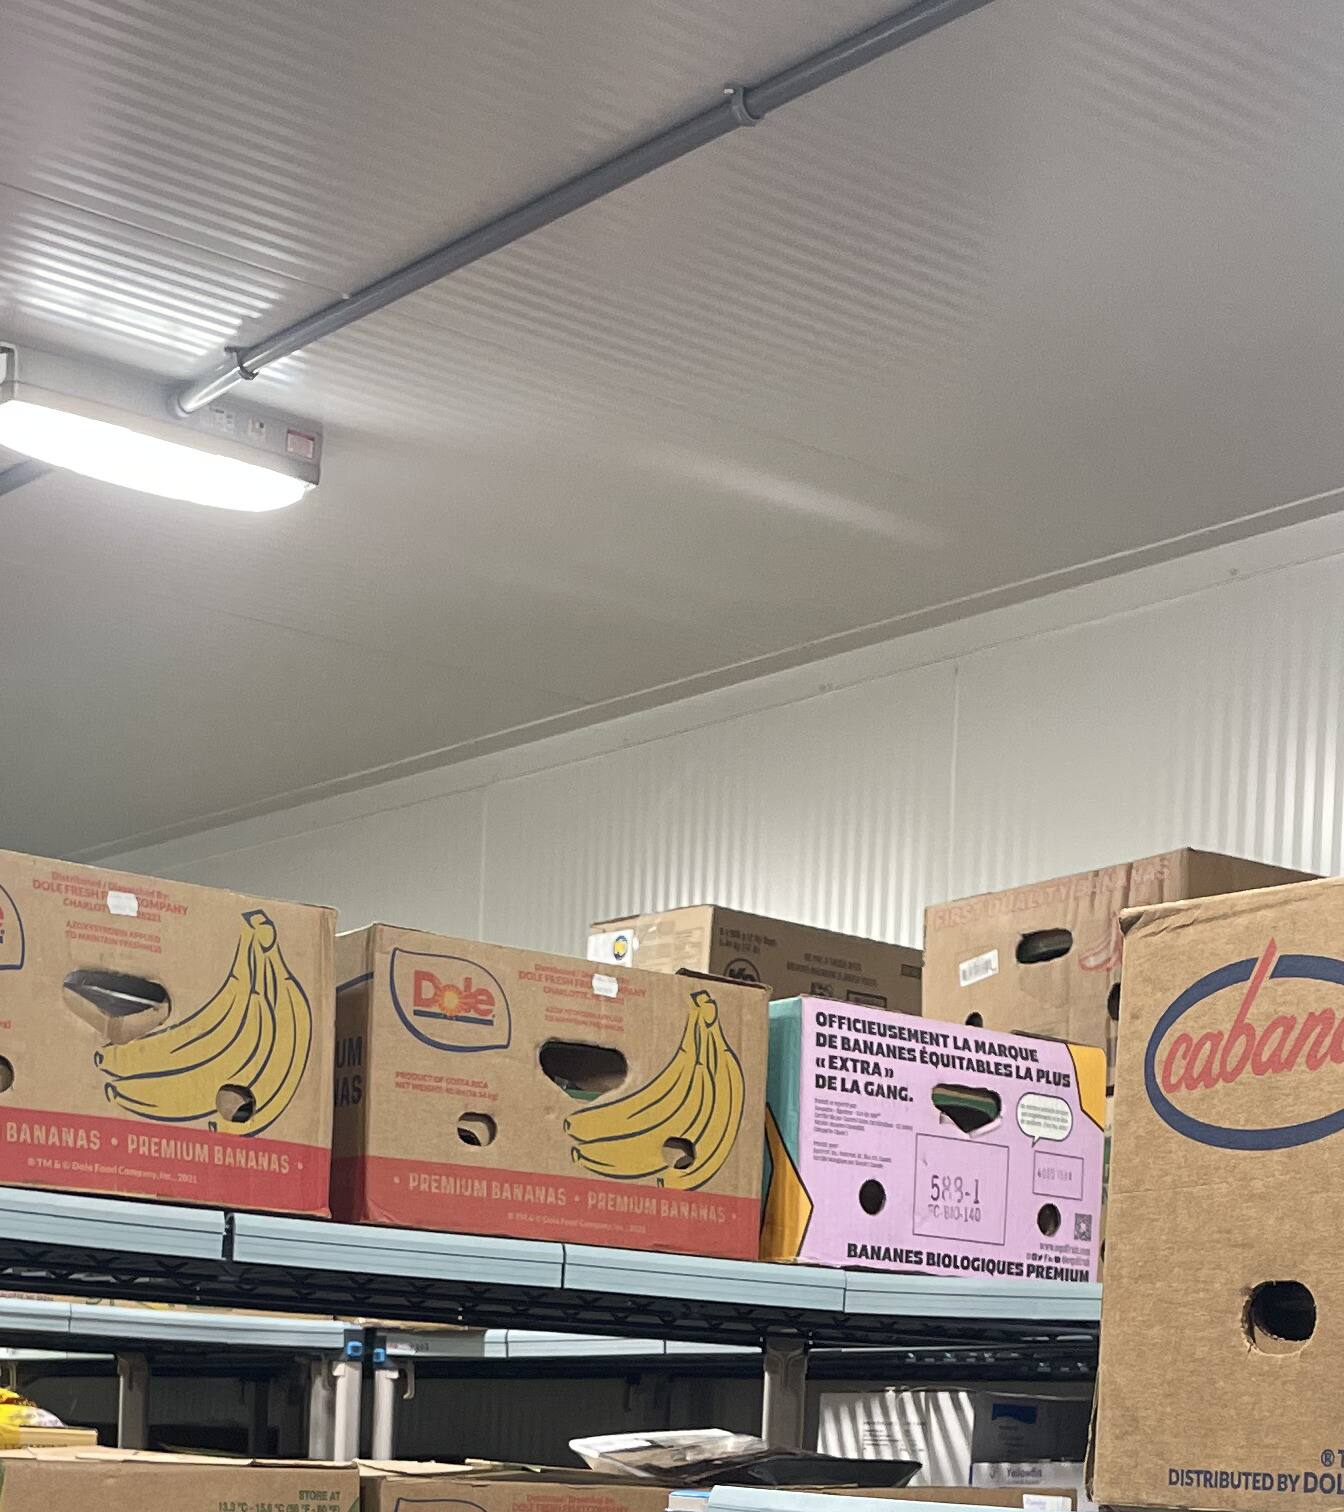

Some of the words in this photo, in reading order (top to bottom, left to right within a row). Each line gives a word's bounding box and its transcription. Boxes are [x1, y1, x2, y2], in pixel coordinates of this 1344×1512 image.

[33, 880, 63, 894] DOLE
[64, 884, 99, 899] FRESH
[414, 970, 495, 1017] Dole
[815, 1011, 949, 1048] OFFICIEUSEMENT
[952, 1035, 971, 1051] LA
[974, 1038, 1039, 1063] MARQUE
[815, 1032, 837, 1049] DE
[841, 1035, 916, 1063] BANANES
[919, 1045, 1013, 1078] ÉQUITABLES
[1015, 1066, 1033, 1081] LA
[1036, 1069, 1072, 1088] PLUS
[815, 1074, 837, 1091] DE
[840, 1077, 861, 1094] LA
[864, 1080, 914, 1102] GANG.
[6, 1121, 101, 1151] BANANAS
[127, 1133, 209, 1164] PREMIUM
[213, 1146, 290, 1174] BANANAS
[409, 1172, 487, 1198] PREMIUM
[491, 1182, 566, 1206] BANANAS
[587, 1191, 657, 1216] PREMIUM
[660, 1200, 725, 1224] BANANAS
[847, 1242, 923, 1266] BANANES
[926, 1250, 1024, 1279] BIOLOGIQUES
[1026, 1261, 1090, 1283] PREMIUM
[299, 1490, 328, 1501] STORE
[330, 1490, 341, 1501] AT
[1168, 1468, 1275, 1492] DISTRIBUTED
[1277, 1473, 1300, 1494] BY
